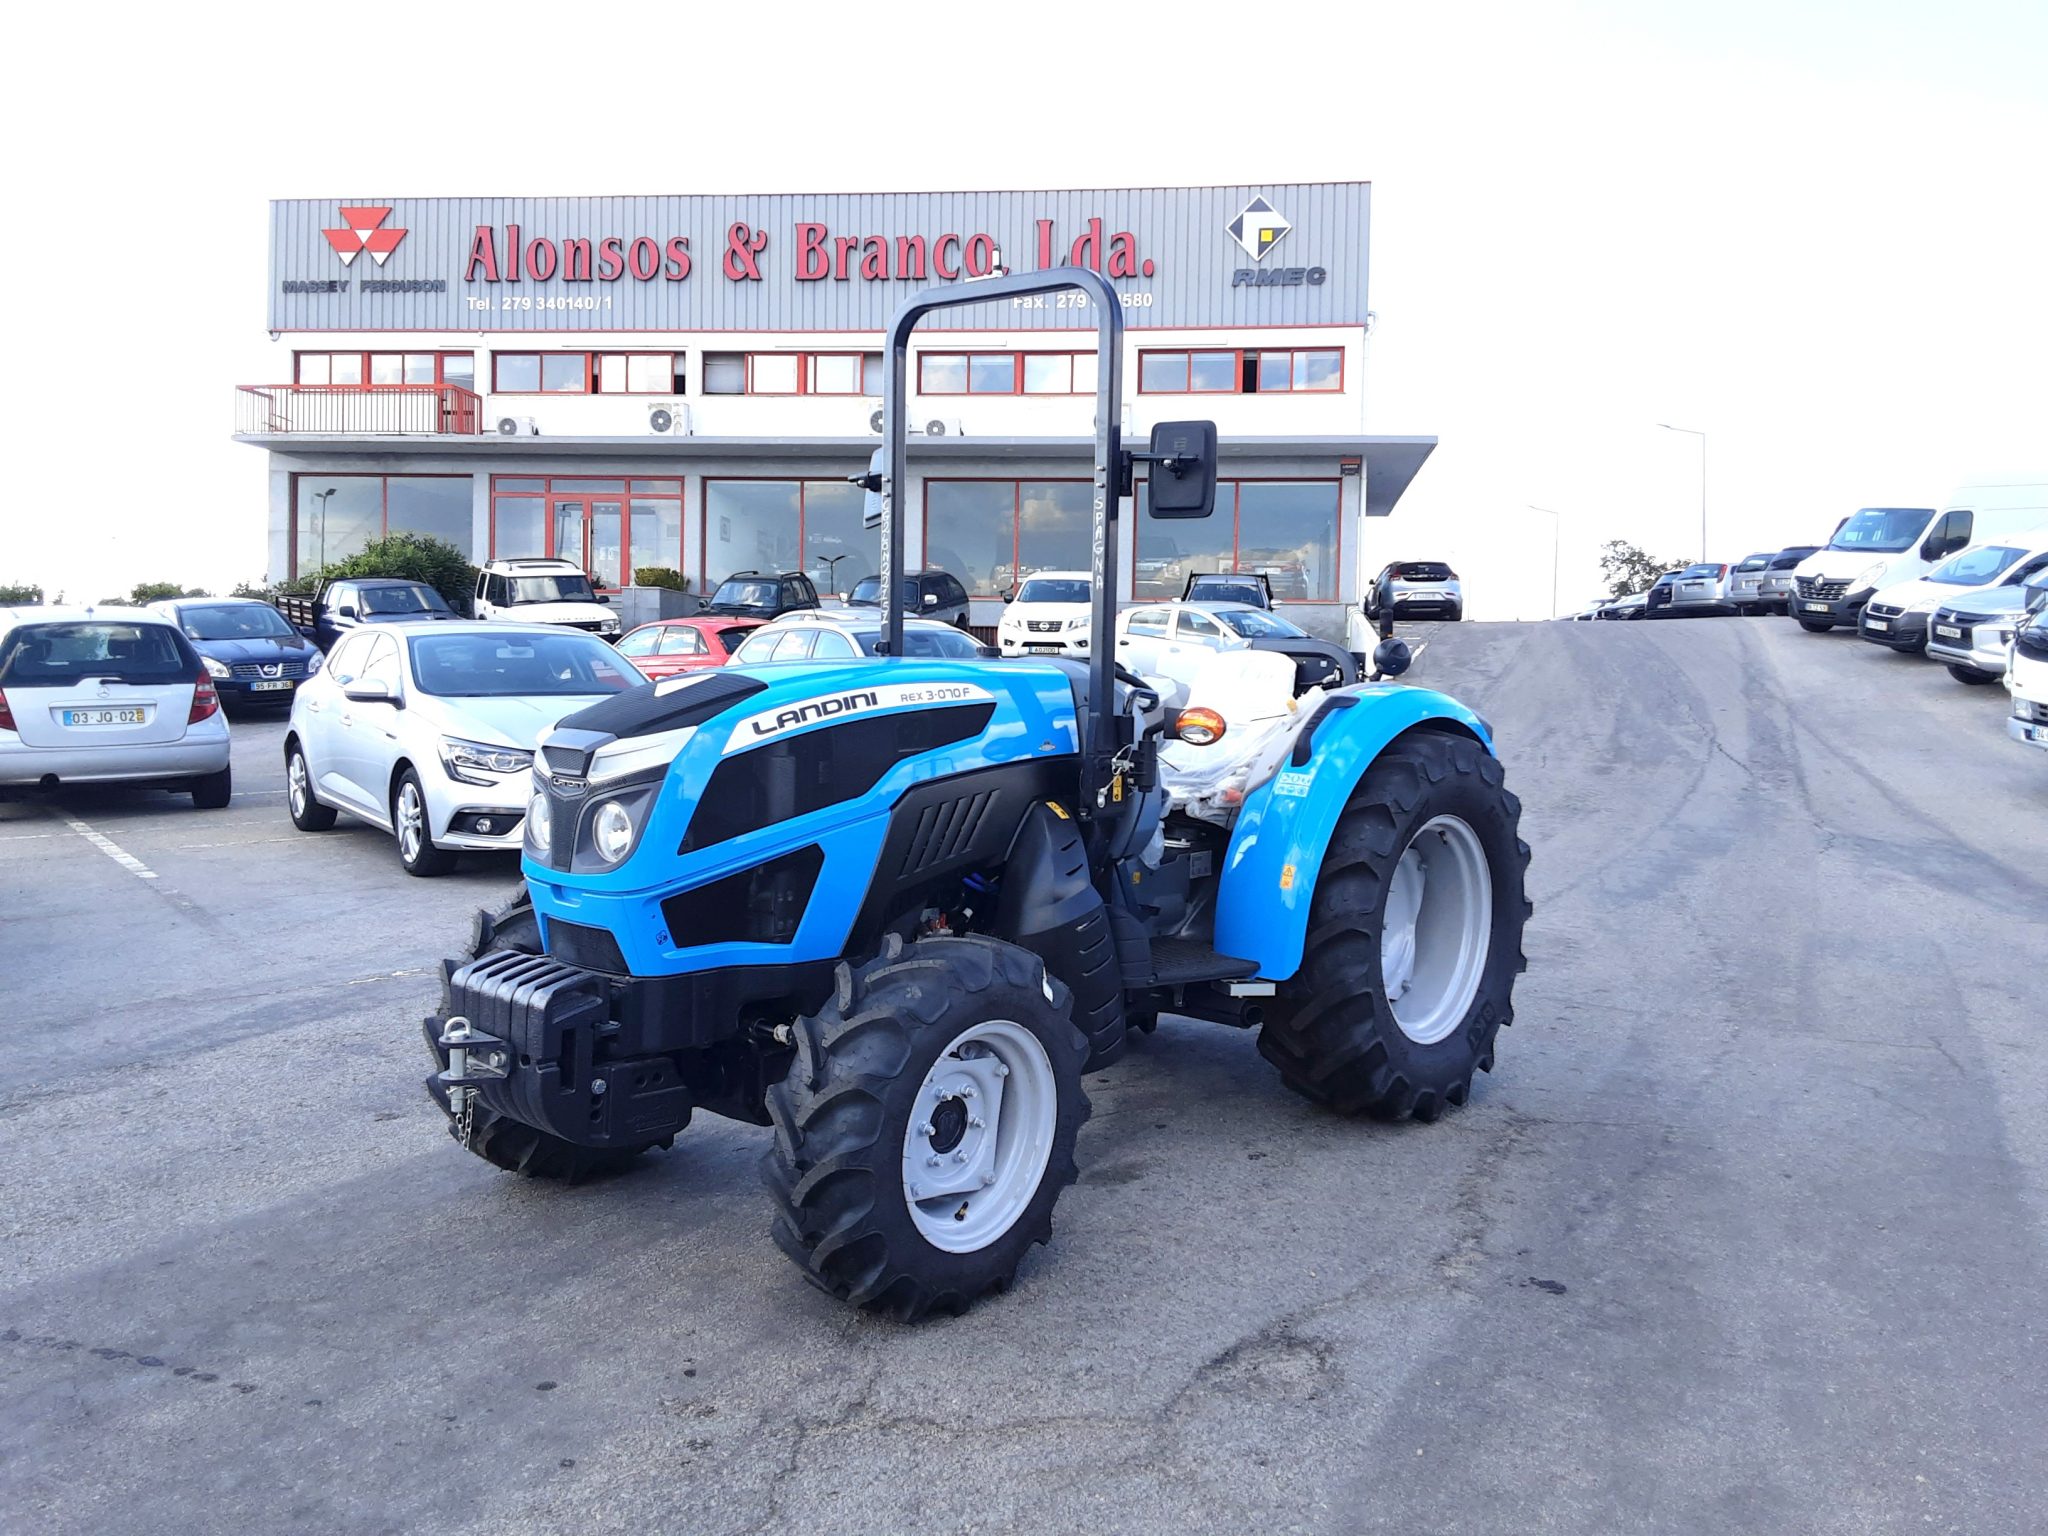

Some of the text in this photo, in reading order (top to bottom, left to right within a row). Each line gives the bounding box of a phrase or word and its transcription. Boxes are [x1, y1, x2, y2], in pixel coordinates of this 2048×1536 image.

[464, 224, 692, 282] Alonsos
[722, 222, 768, 281] &
[282, 279, 446, 293] MASSEY FERGUSON
[1232, 266, 1327, 288] RMEC
[467, 296, 495, 310] Tel.
[502, 296, 531, 310] 279
[1013, 294, 1049, 309] Fax.
[1057, 293, 1087, 309] 279
[1093, 496, 1104, 590] SPAGNA
[900, 692, 923, 703] REX
[751, 691, 879, 736] LANDINI
